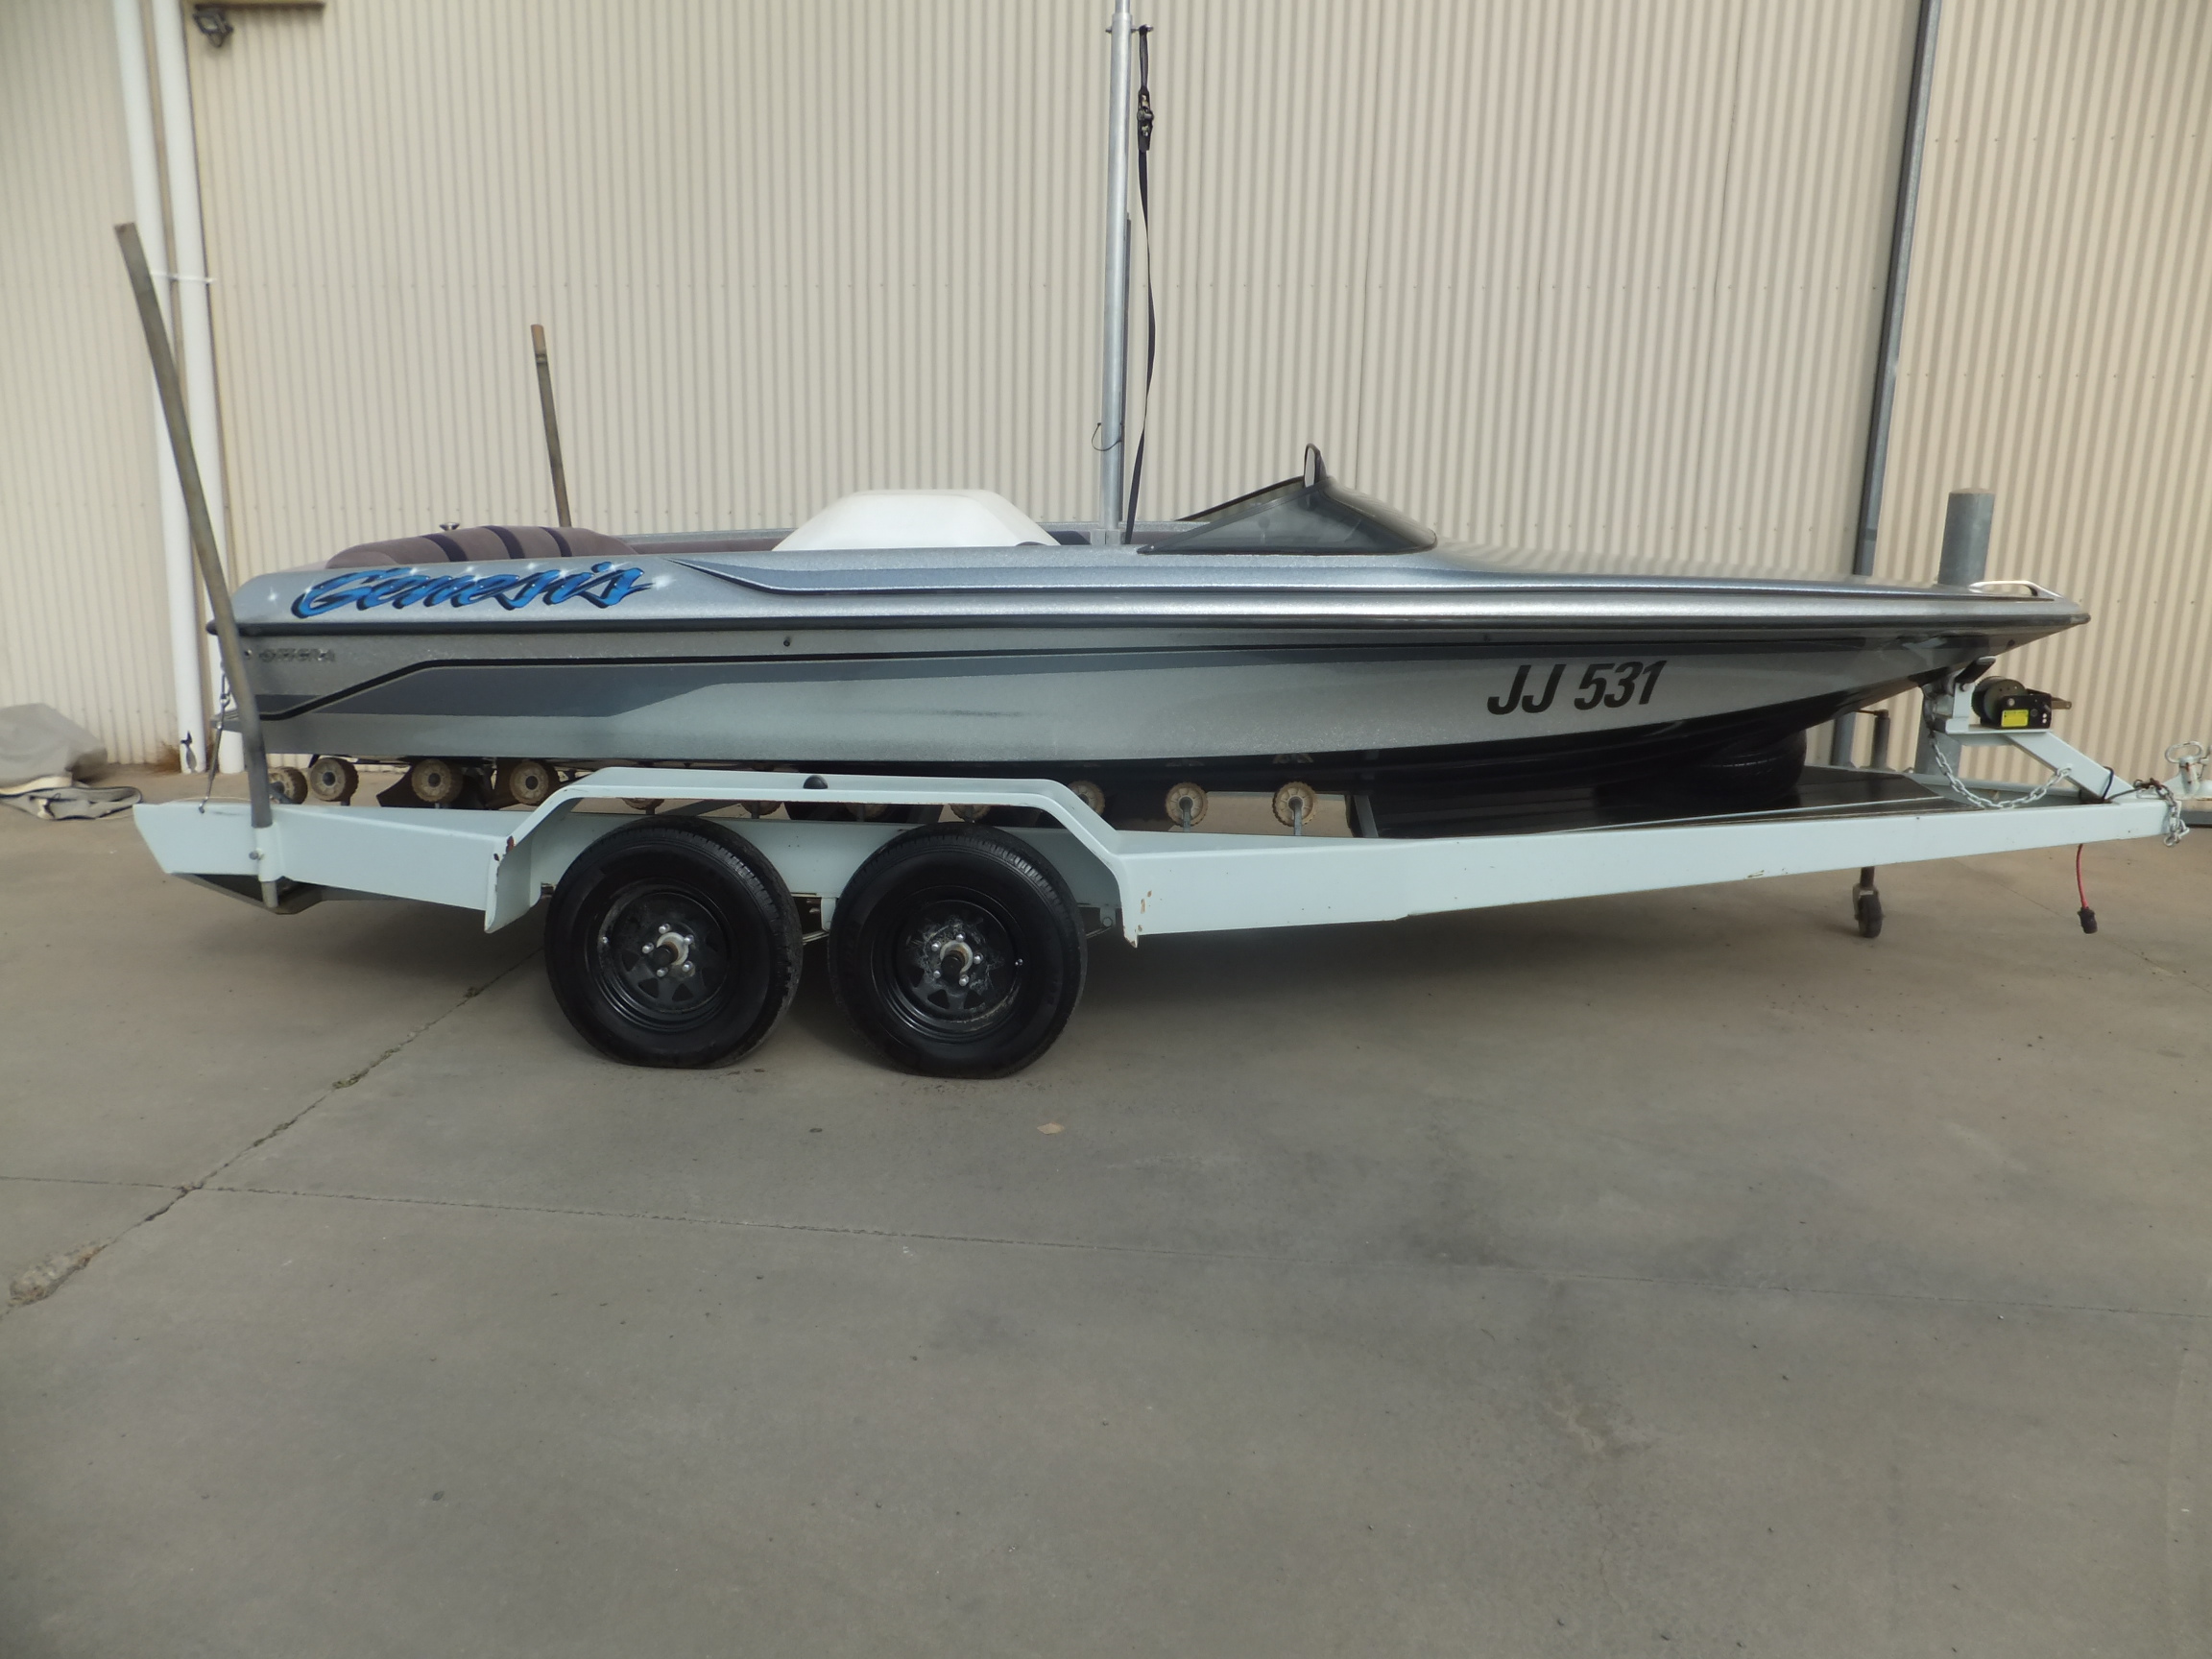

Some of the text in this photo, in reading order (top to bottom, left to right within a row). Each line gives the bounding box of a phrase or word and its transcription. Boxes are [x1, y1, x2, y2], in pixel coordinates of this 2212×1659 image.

[291, 561, 654, 619] Genesis
[1487, 661, 1668, 715] JJ 531
